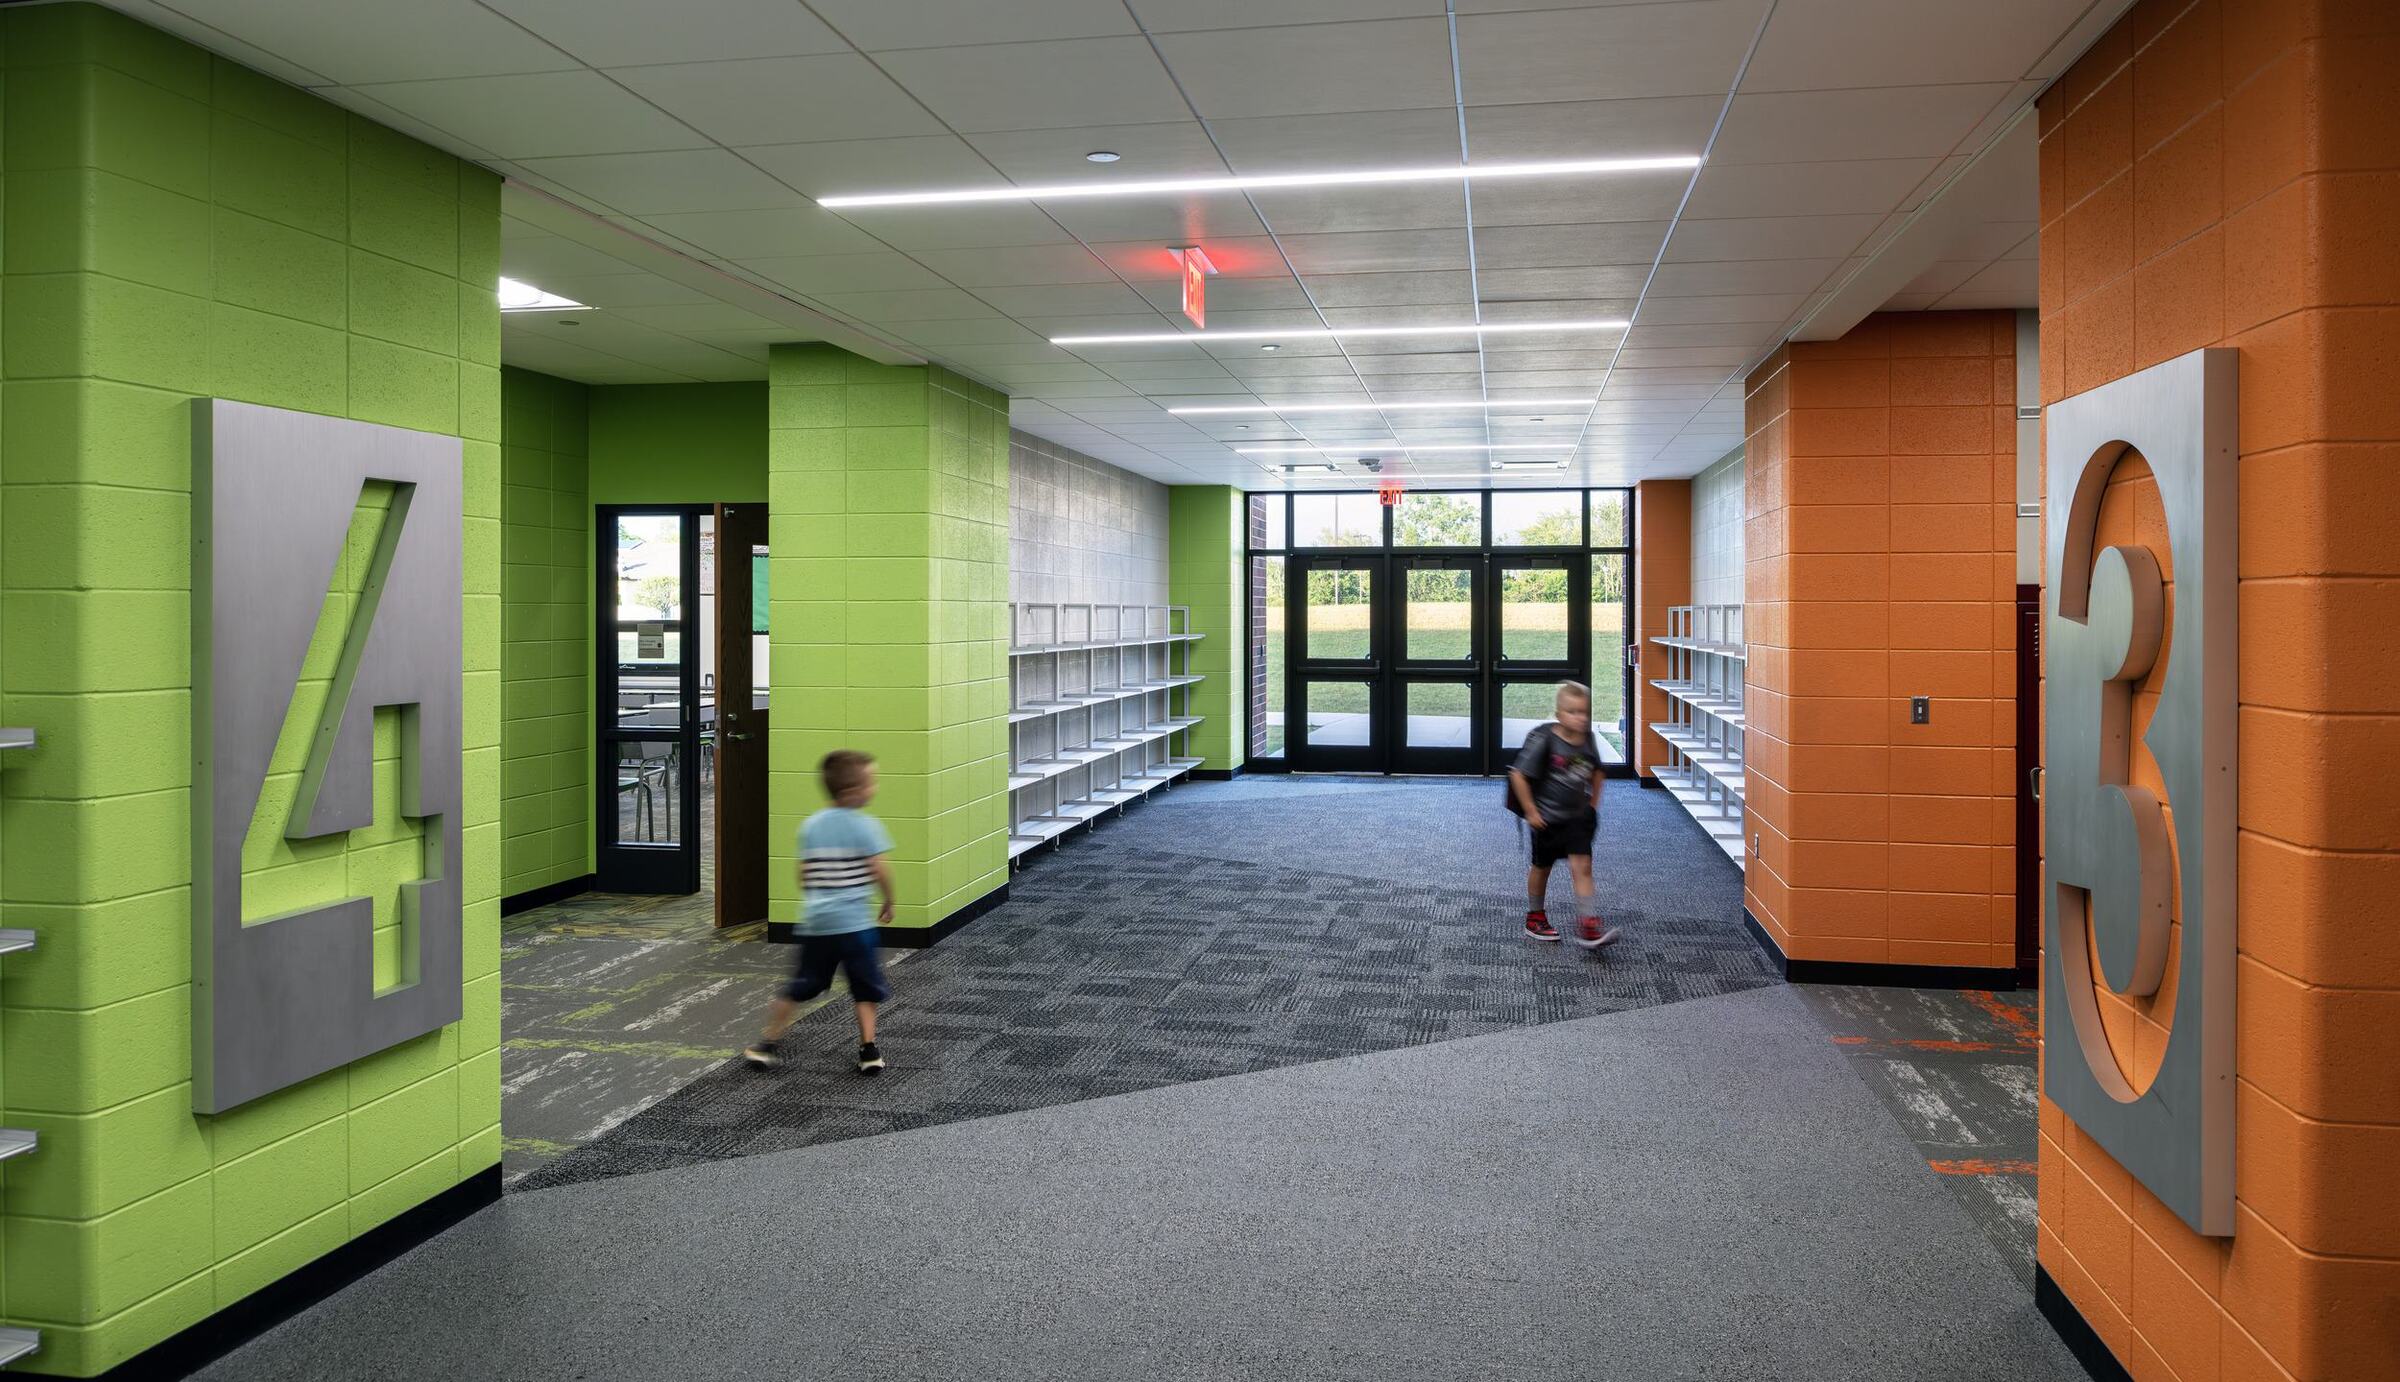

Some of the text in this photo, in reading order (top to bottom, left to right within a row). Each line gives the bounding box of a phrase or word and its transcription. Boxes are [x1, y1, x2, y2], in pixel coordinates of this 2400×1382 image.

[1188, 261, 1202, 321] EXIT
[1379, 488, 1402, 505] EXIT
[241, 477, 443, 999] 4
[2057, 438, 2182, 1104] 3
